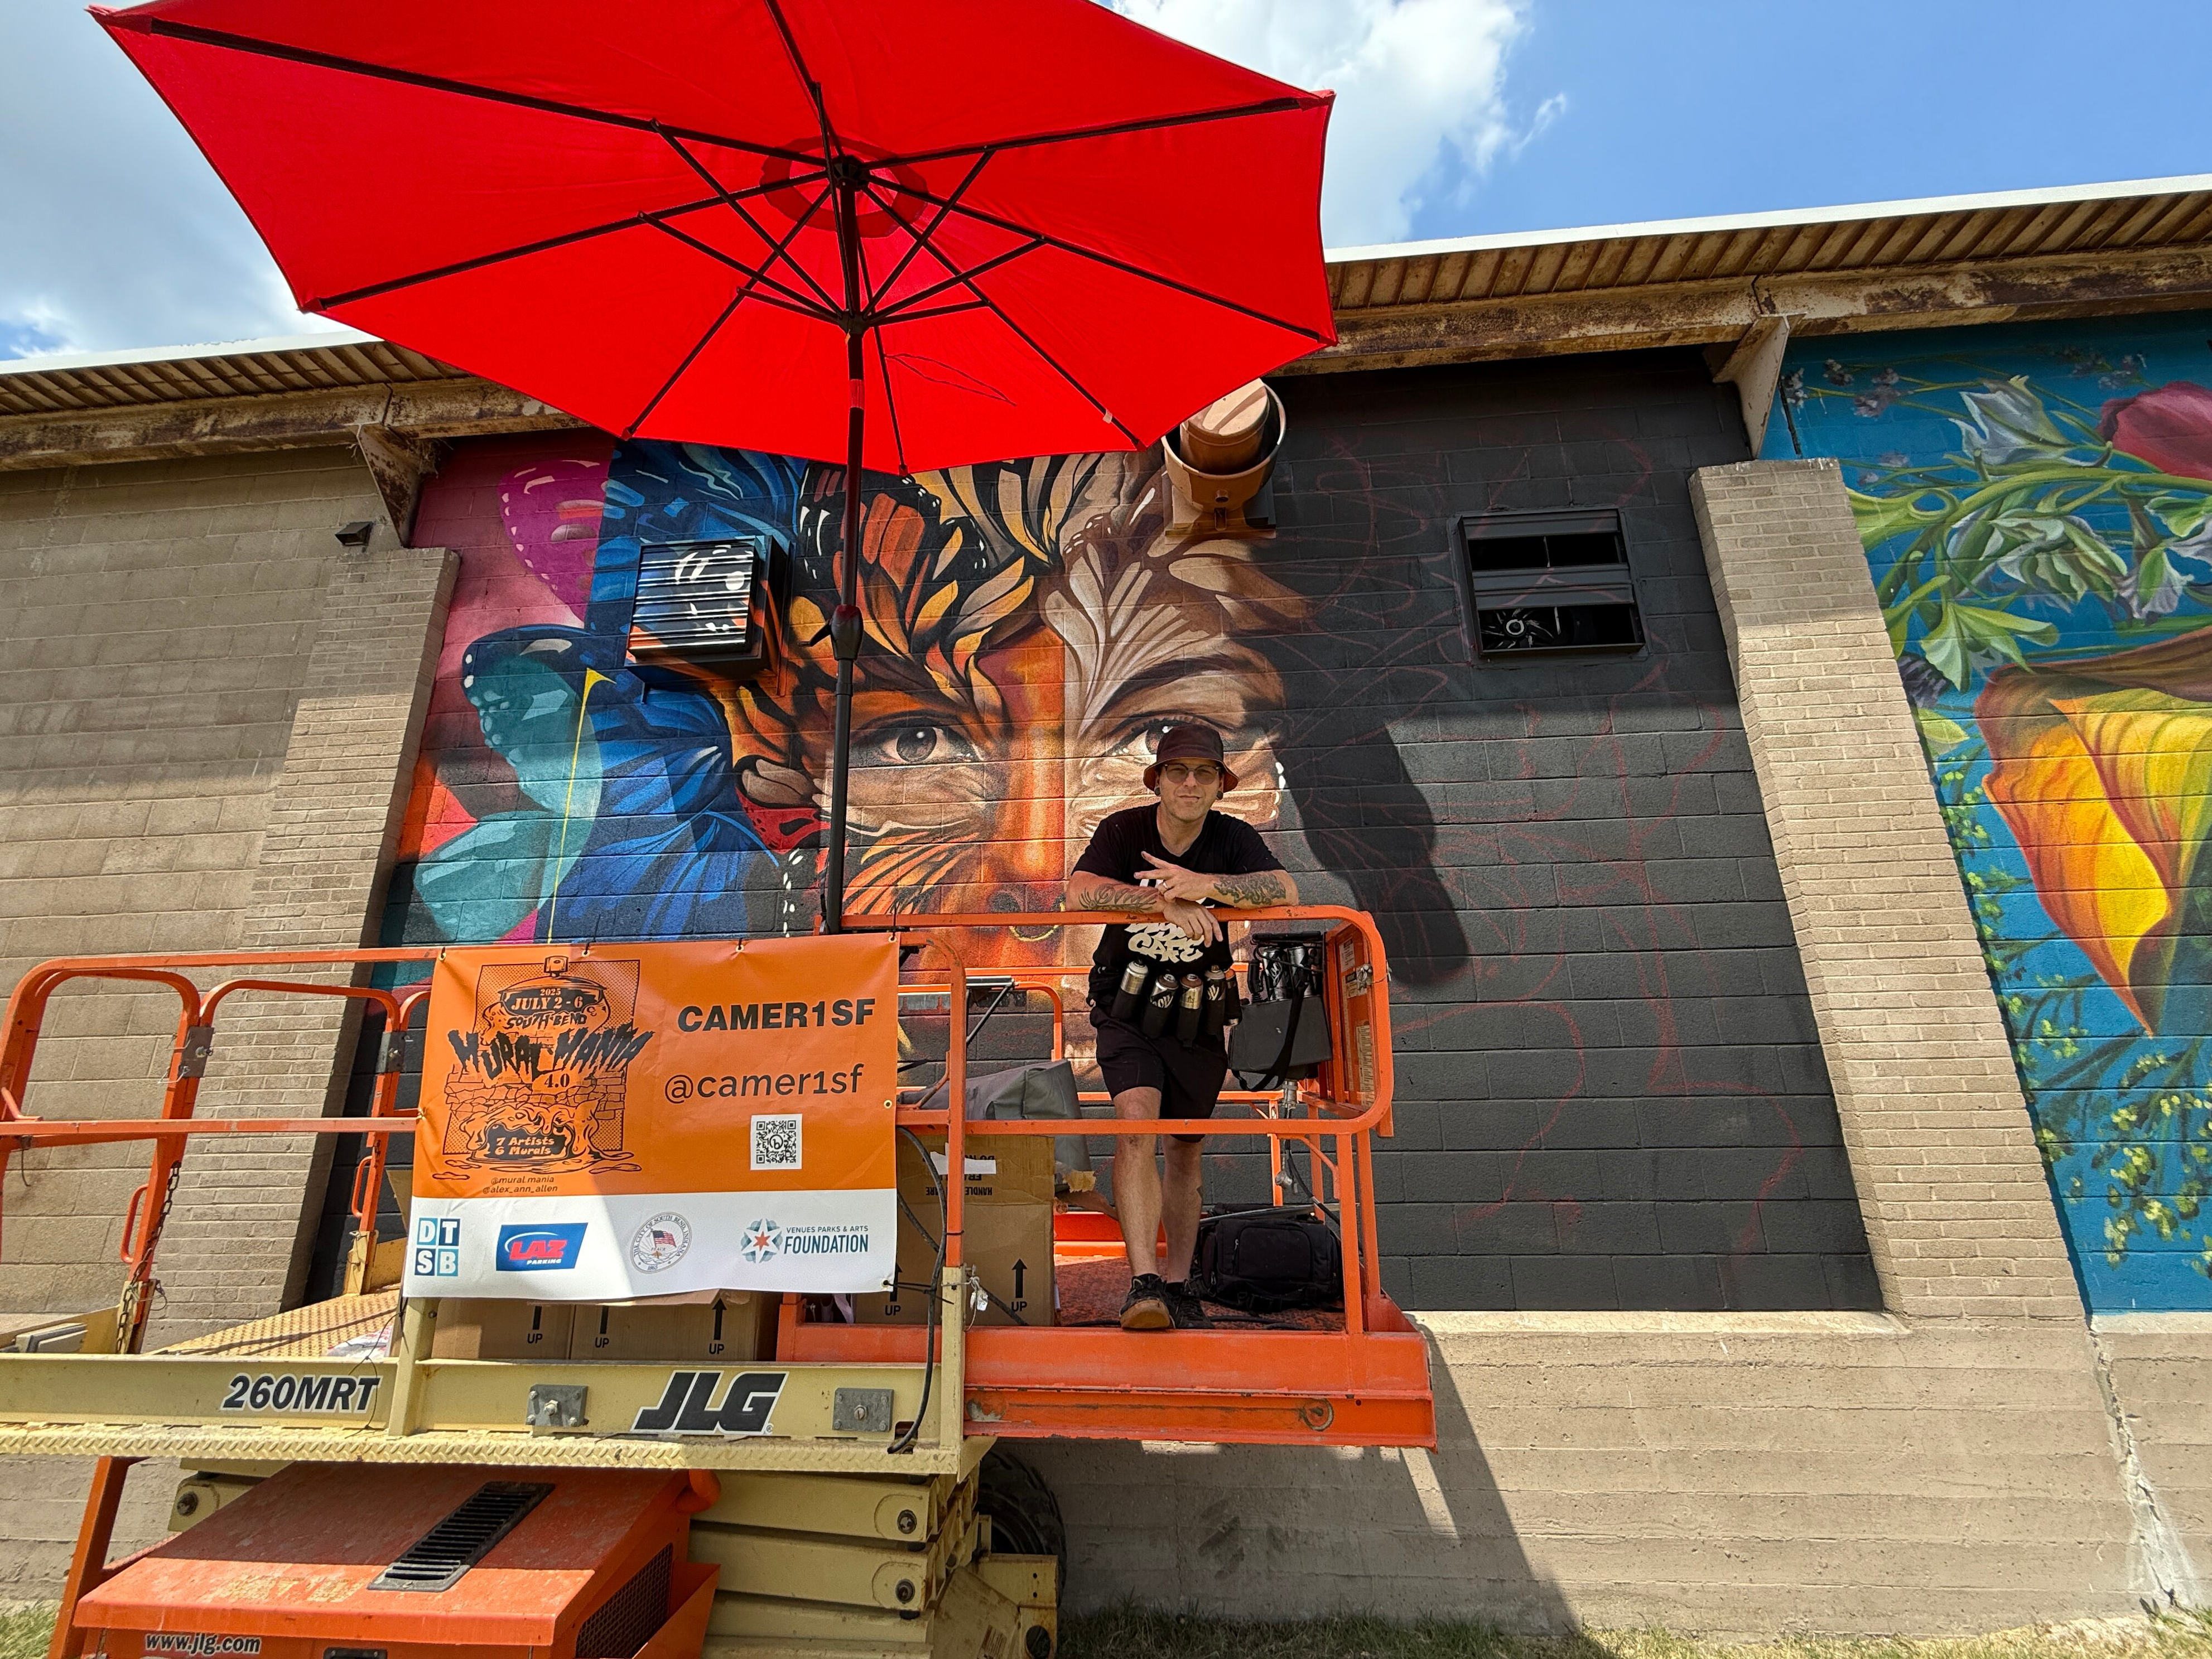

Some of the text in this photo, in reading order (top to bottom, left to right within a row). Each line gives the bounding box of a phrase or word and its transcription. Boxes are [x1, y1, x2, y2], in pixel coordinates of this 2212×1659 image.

[540, 988, 561, 996] 2025
[511, 996, 551, 1011] JULY
[554, 996, 562, 1009] 2
[574, 995, 584, 1009] 6
[507, 1011, 587, 1029] SOUTH BEND
[677, 998, 876, 1033] CAMER1SF
[447, 1021, 656, 1081] MURAL MANIA
[544, 1073, 570, 1088] 4.0
[664, 1063, 865, 1105] @camer1sf
[496, 1136, 555, 1146] 7 Artists
[495, 1146, 552, 1155] 6 Murals
[483, 1184, 558, 1194] @alex_ann_allen
[965, 1187, 992, 1196] HANDLE
[654, 1215, 673, 1224] SOUTH
[509, 1239, 568, 1261] LAZ
[783, 1234, 869, 1255] FOUNDATION
[884, 1304, 901, 1316] UP
[1010, 1301, 1028, 1312] UP
[526, 1333, 543, 1344] UP
[594, 1337, 610, 1349] UP
[708, 1343, 725, 1356] UP
[223, 1375, 381, 1411] 260MRT
[634, 1372, 788, 1432] JLG
[146, 1633, 261, 1655] www.jlg.com
